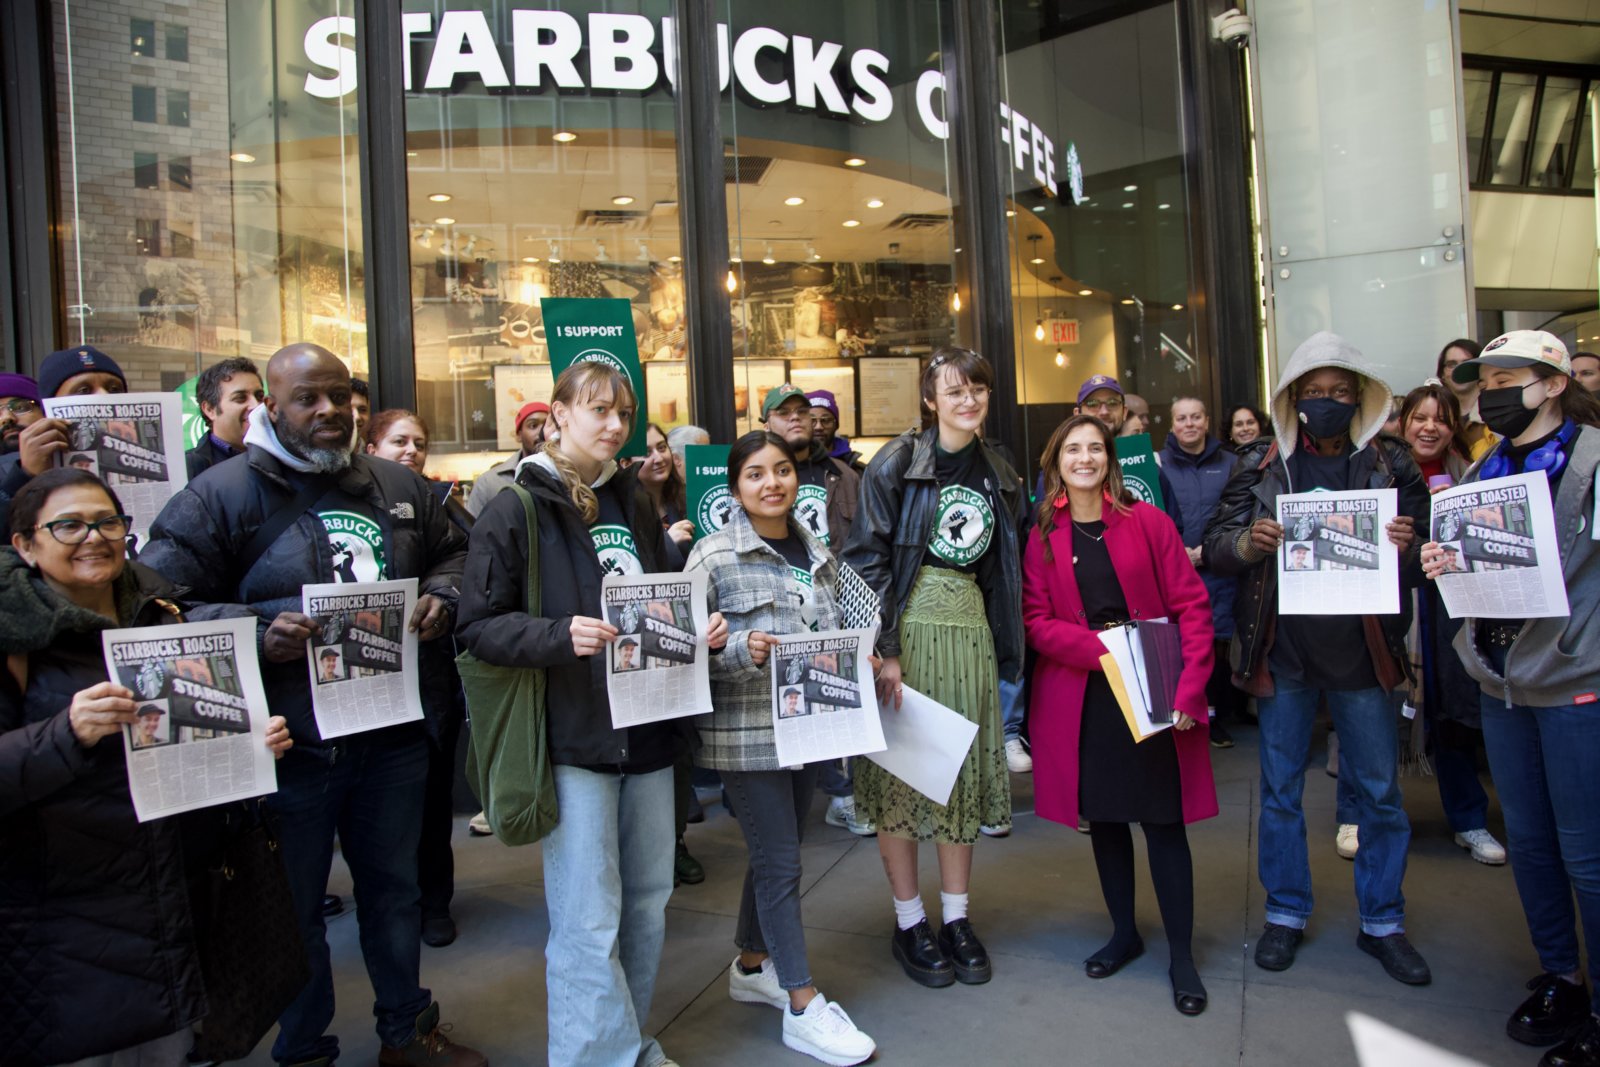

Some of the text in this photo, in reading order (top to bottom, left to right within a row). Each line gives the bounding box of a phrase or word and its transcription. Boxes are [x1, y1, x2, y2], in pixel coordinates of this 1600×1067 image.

[915, 69, 1058, 196] CFEE
[556, 325, 623, 337] I SUPPORT
[1053, 322, 1077, 342] EXIT
[53, 404, 161, 419] STARBUCKS ROASTED
[120, 454, 162, 474] COFFEE
[1117, 454, 1147, 467] PORT
[695, 466, 700, 475] I
[1122, 479, 1145, 492] BUCKS
[705, 487, 732, 505] STARB
[939, 490, 989, 515] STARBUCKS
[1434, 493, 1479, 513] STARBUCKS
[1481, 486, 1527, 504] ROASTED
[1282, 502, 1334, 514] STARBUCKS
[1337, 499, 1377, 512] ROASTED
[322, 518, 383, 547] RBUCKS
[701, 511, 718, 535] WORK
[1333, 544, 1372, 562] COFFEE
[1483, 541, 1529, 559] COFFEE
[311, 594, 365, 612] STARBUCKS
[367, 591, 405, 607] ROASTED
[606, 583, 690, 601] STARBUCKS ROASTED
[112, 639, 181, 661] STARBUCKS
[182, 634, 233, 654] ROASTED
[361, 645, 397, 664] COFFEE
[658, 636, 691, 656] COFFEE
[776, 641, 822, 656] STARBUCKS
[823, 637, 859, 651] ROASTED
[821, 684, 856, 701] COFFEE
[194, 700, 243, 722] COFFEE
